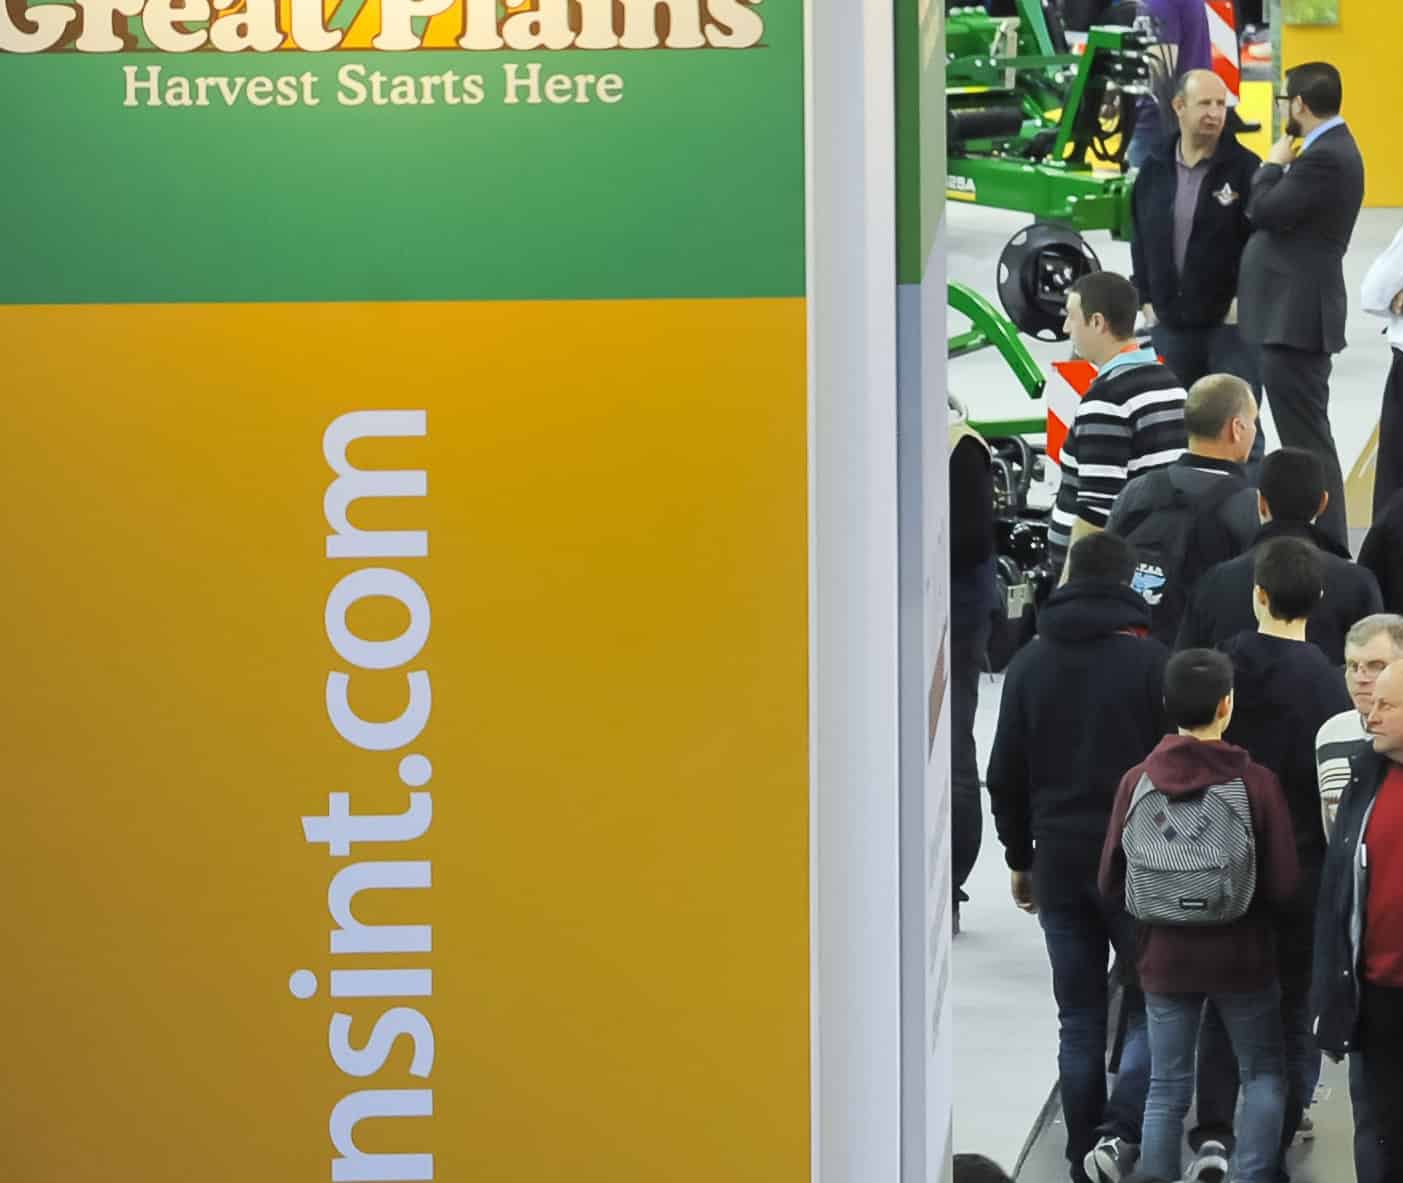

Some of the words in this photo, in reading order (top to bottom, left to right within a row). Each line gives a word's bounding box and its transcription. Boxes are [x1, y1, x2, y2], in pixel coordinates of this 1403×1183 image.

[122, 66, 319, 108] Harvest
[336, 63, 485, 106] Starts
[504, 63, 625, 104] Here
[288, 409, 435, 1183] nsint.com
